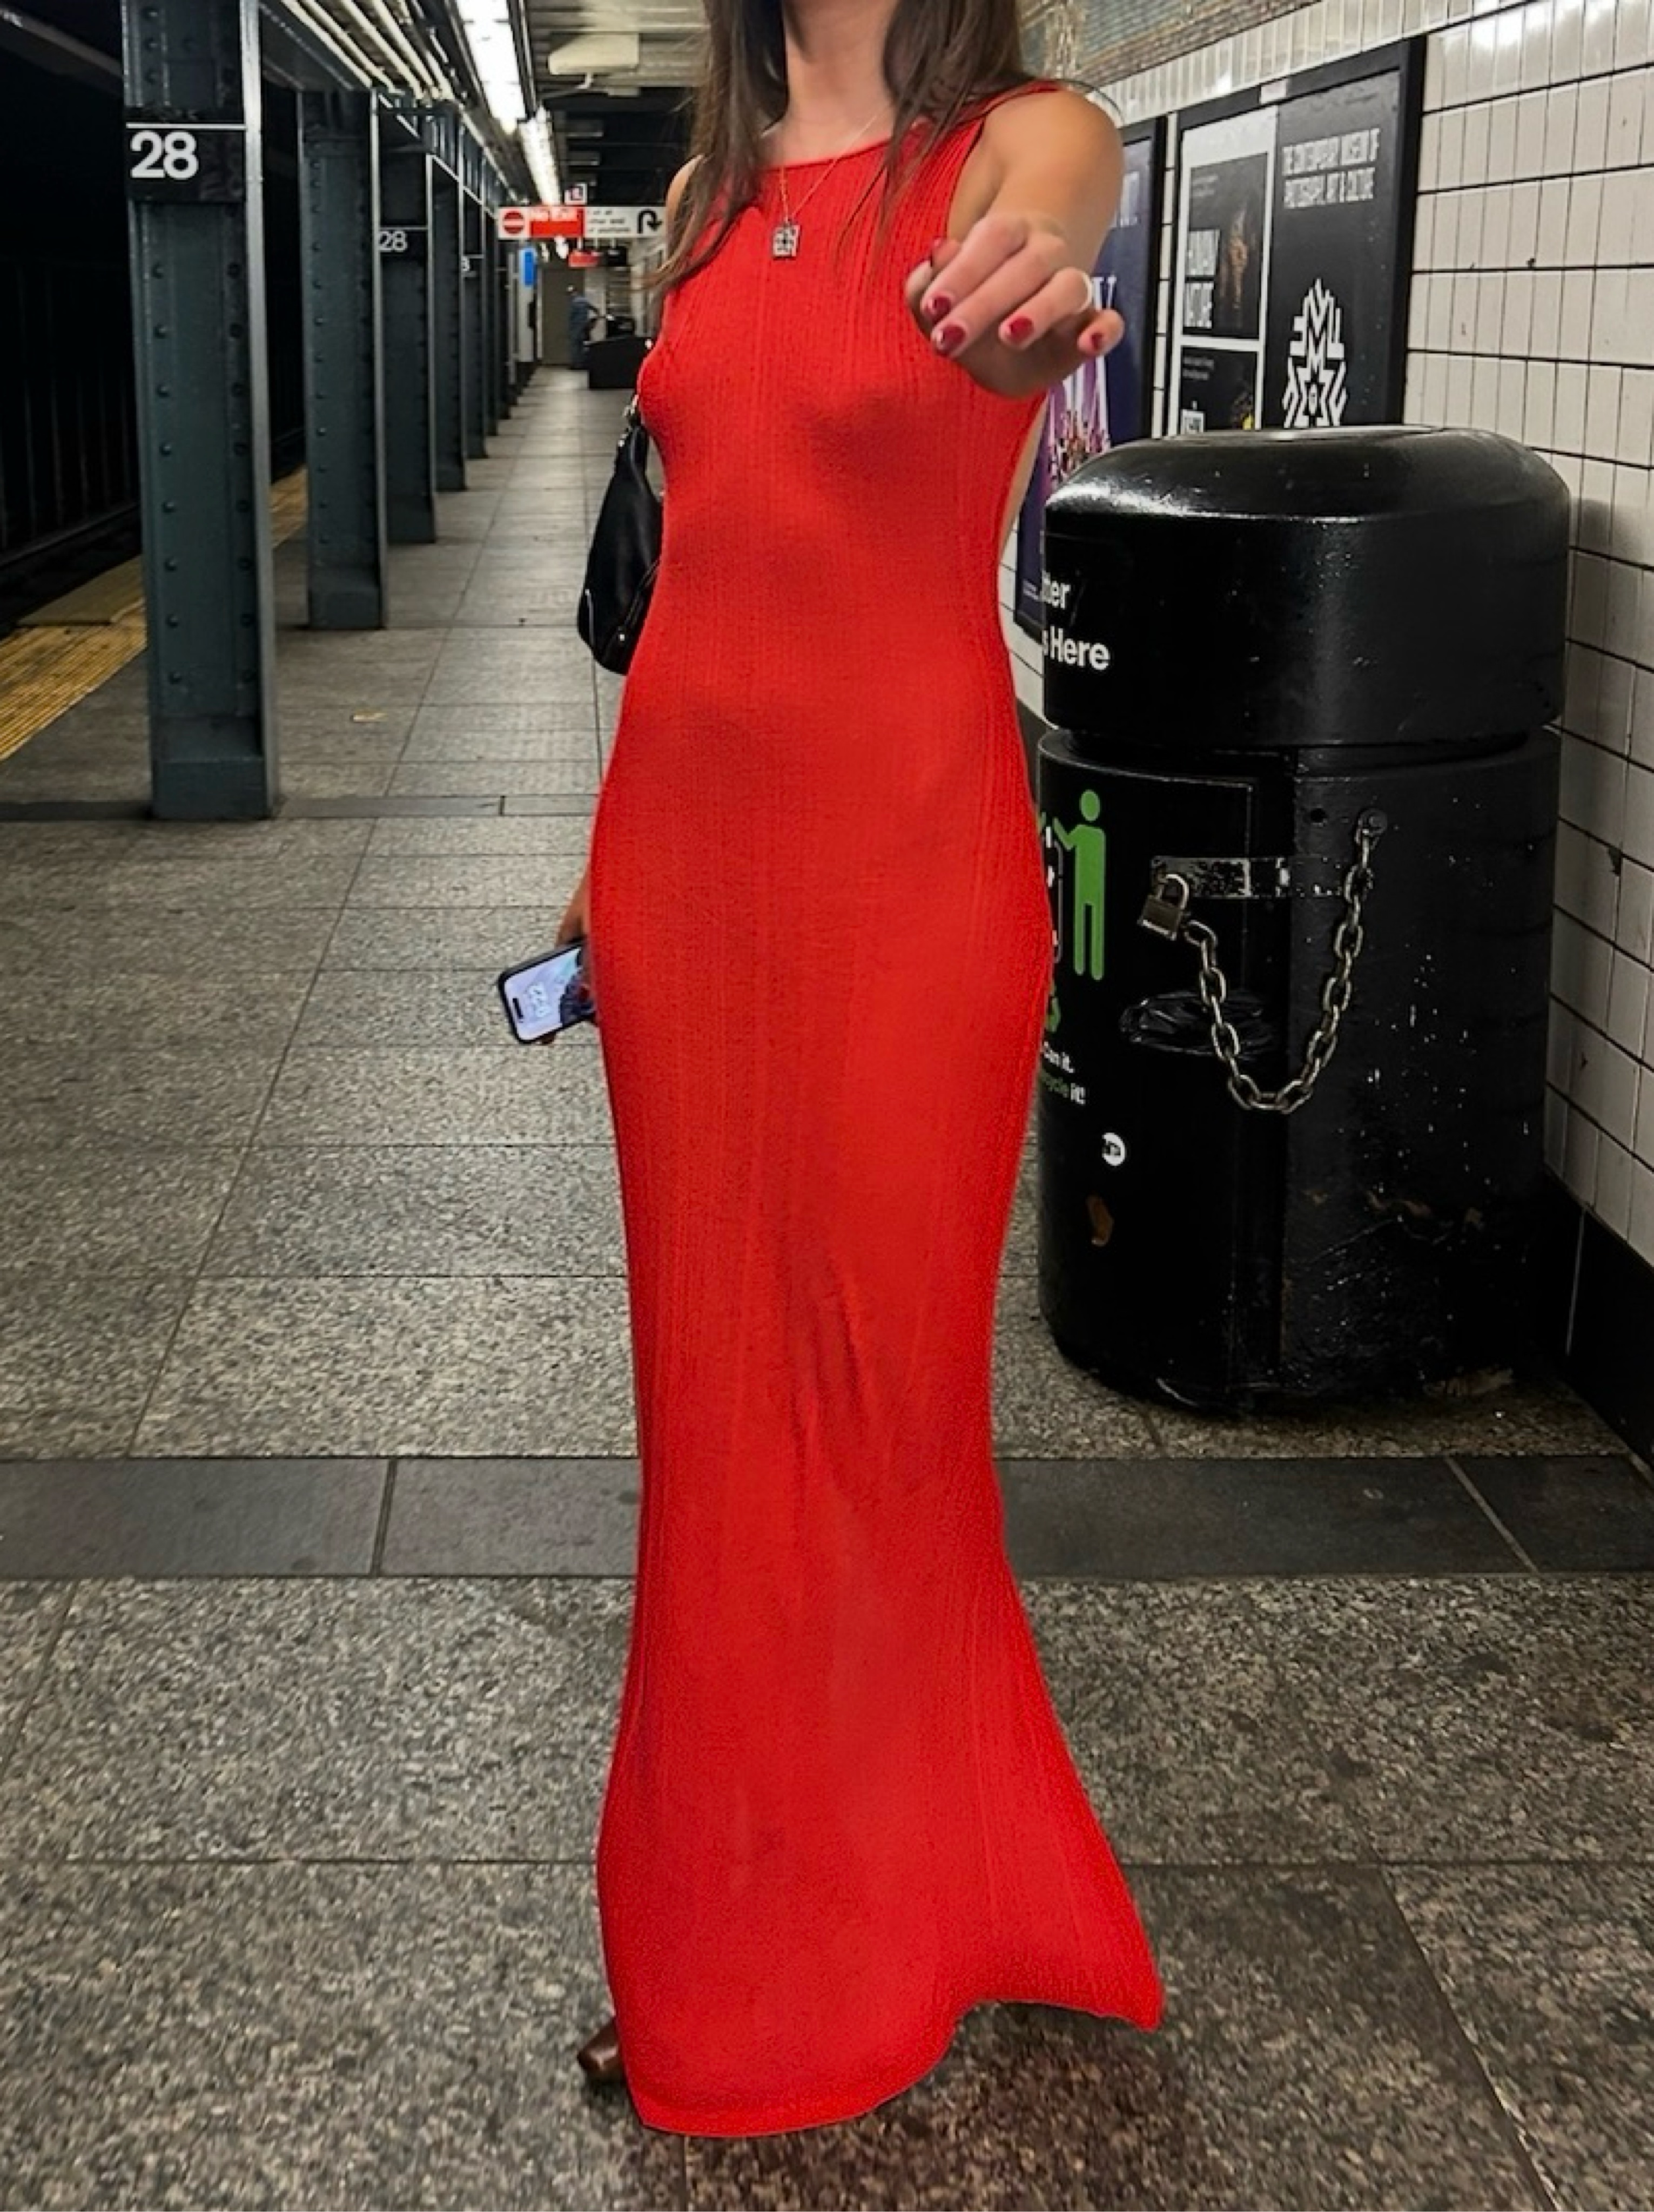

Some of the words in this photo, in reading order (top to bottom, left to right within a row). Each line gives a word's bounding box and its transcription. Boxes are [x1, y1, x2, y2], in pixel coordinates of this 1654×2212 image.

[130, 130, 199, 181] 28
[377, 230, 408, 253] 28
[1050, 625, 1111, 671] Here
